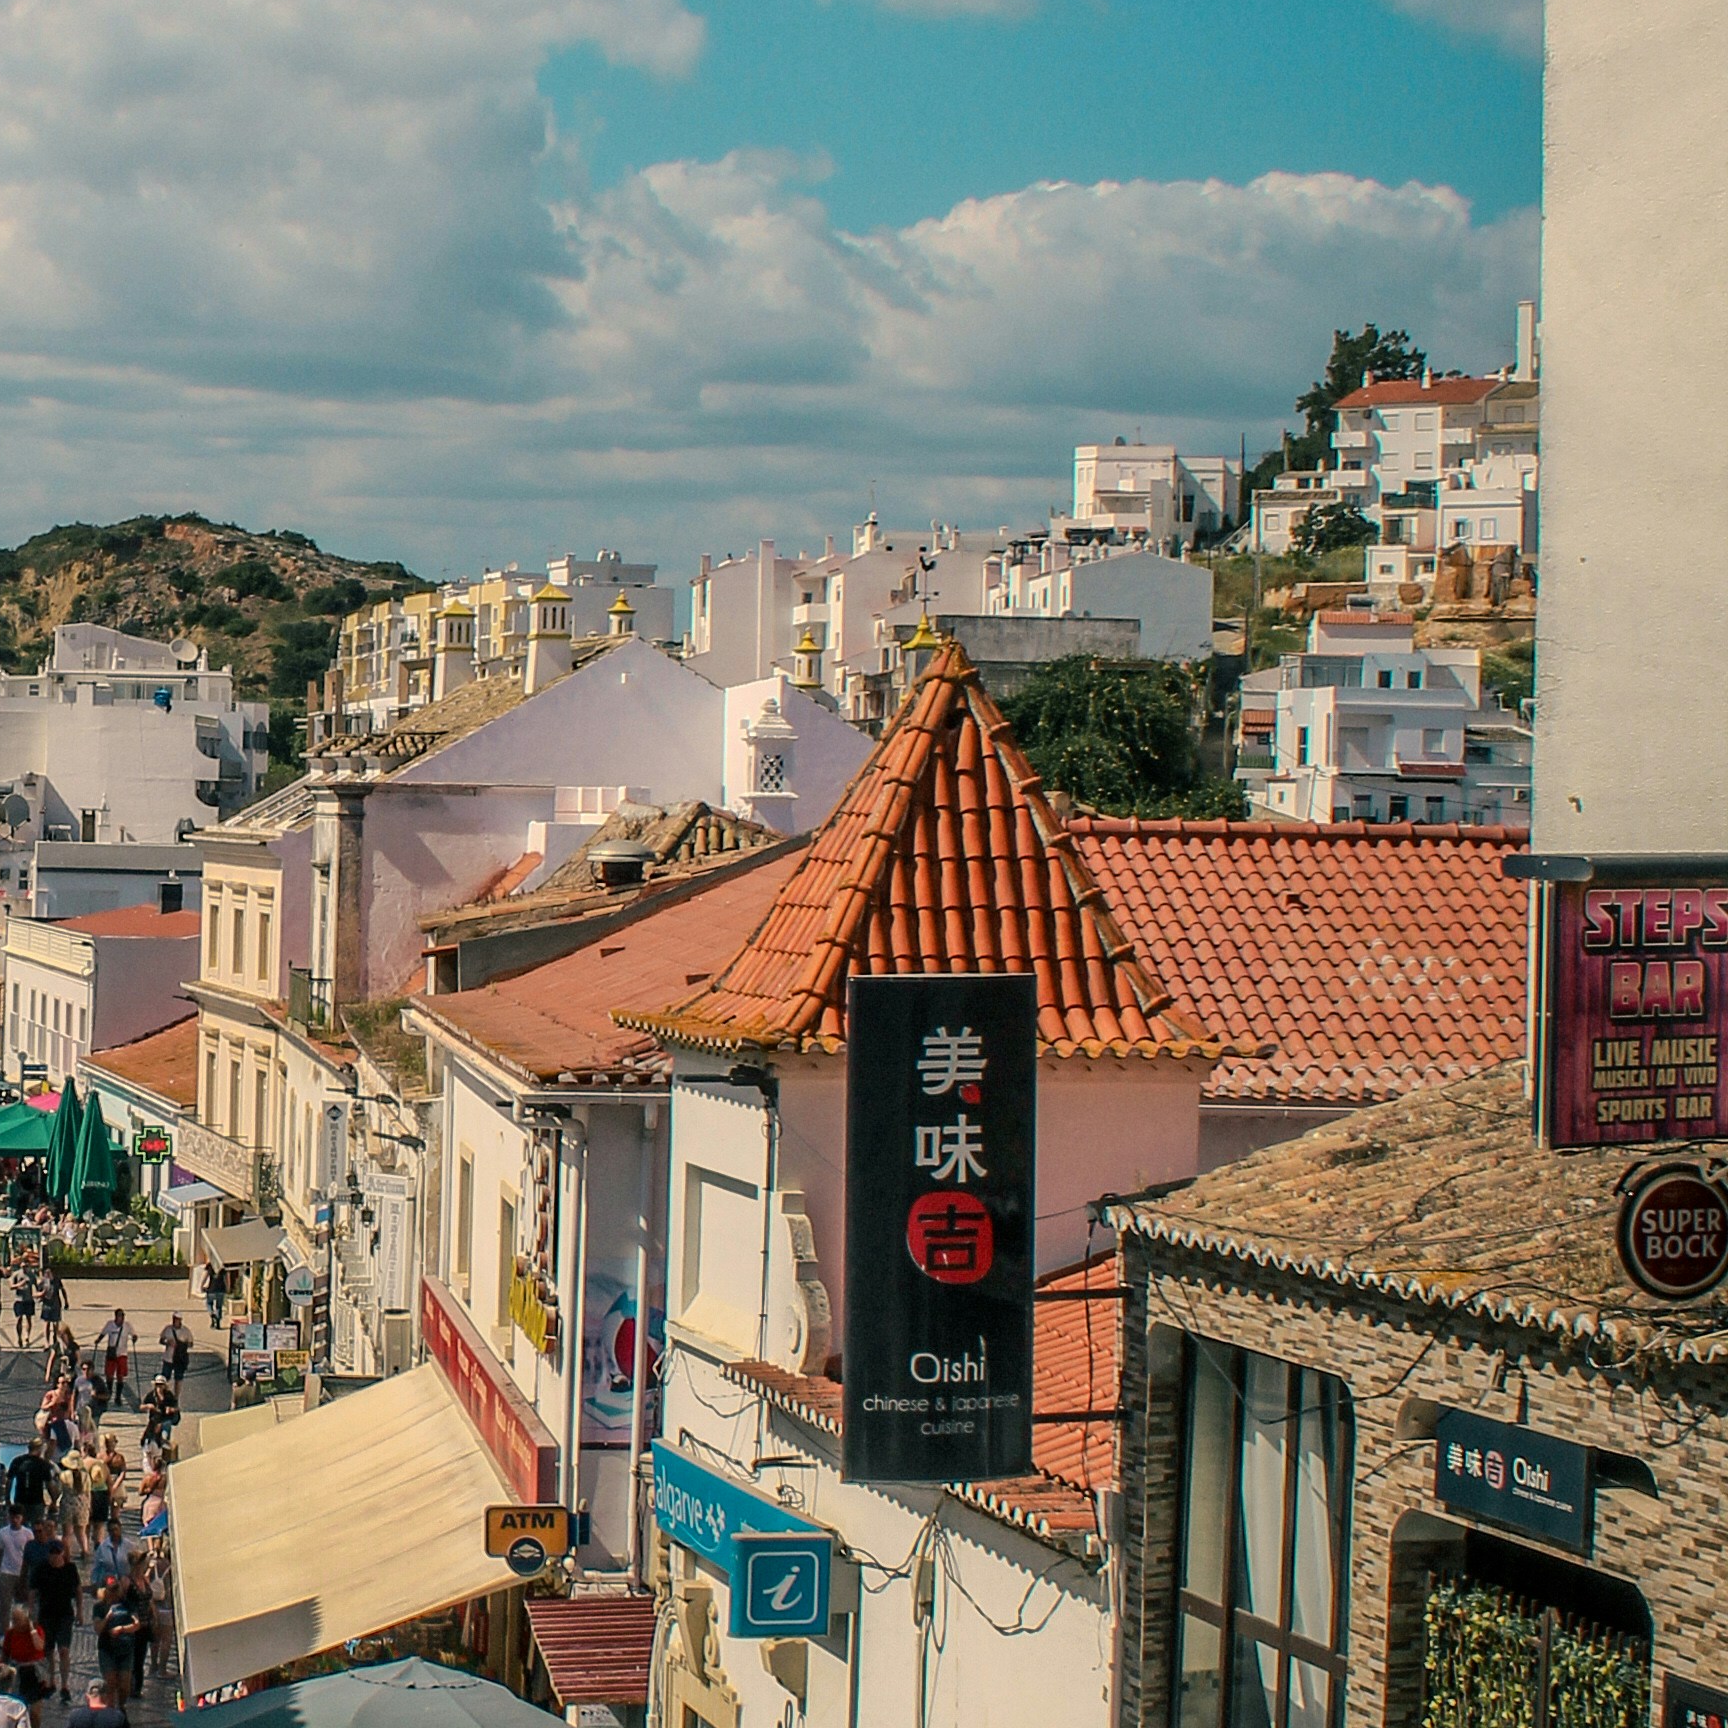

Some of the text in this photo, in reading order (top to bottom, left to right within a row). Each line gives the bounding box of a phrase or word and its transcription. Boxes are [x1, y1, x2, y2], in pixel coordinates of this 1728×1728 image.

[1584, 888, 1728, 948] STEPS
[1610, 960, 1704, 1019] BAR
[1593, 1038, 1718, 1068] LIVE MUSIC
[1592, 1066, 1718, 1090] MUSICA AO VIVO
[1597, 1095, 1713, 1123] SPORTS BAR
[1641, 1208, 1722, 1235] SUPER
[1645, 1234, 1719, 1261] BOCK
[910, 1352, 986, 1383] Oishi
[862, 1393, 1020, 1413] chinese & japanese
[920, 1419, 975, 1436] cuisine
[1513, 1456, 1550, 1492] Oishi
[655, 1465, 704, 1535] algarve
[500, 1512, 555, 1529] ATM
